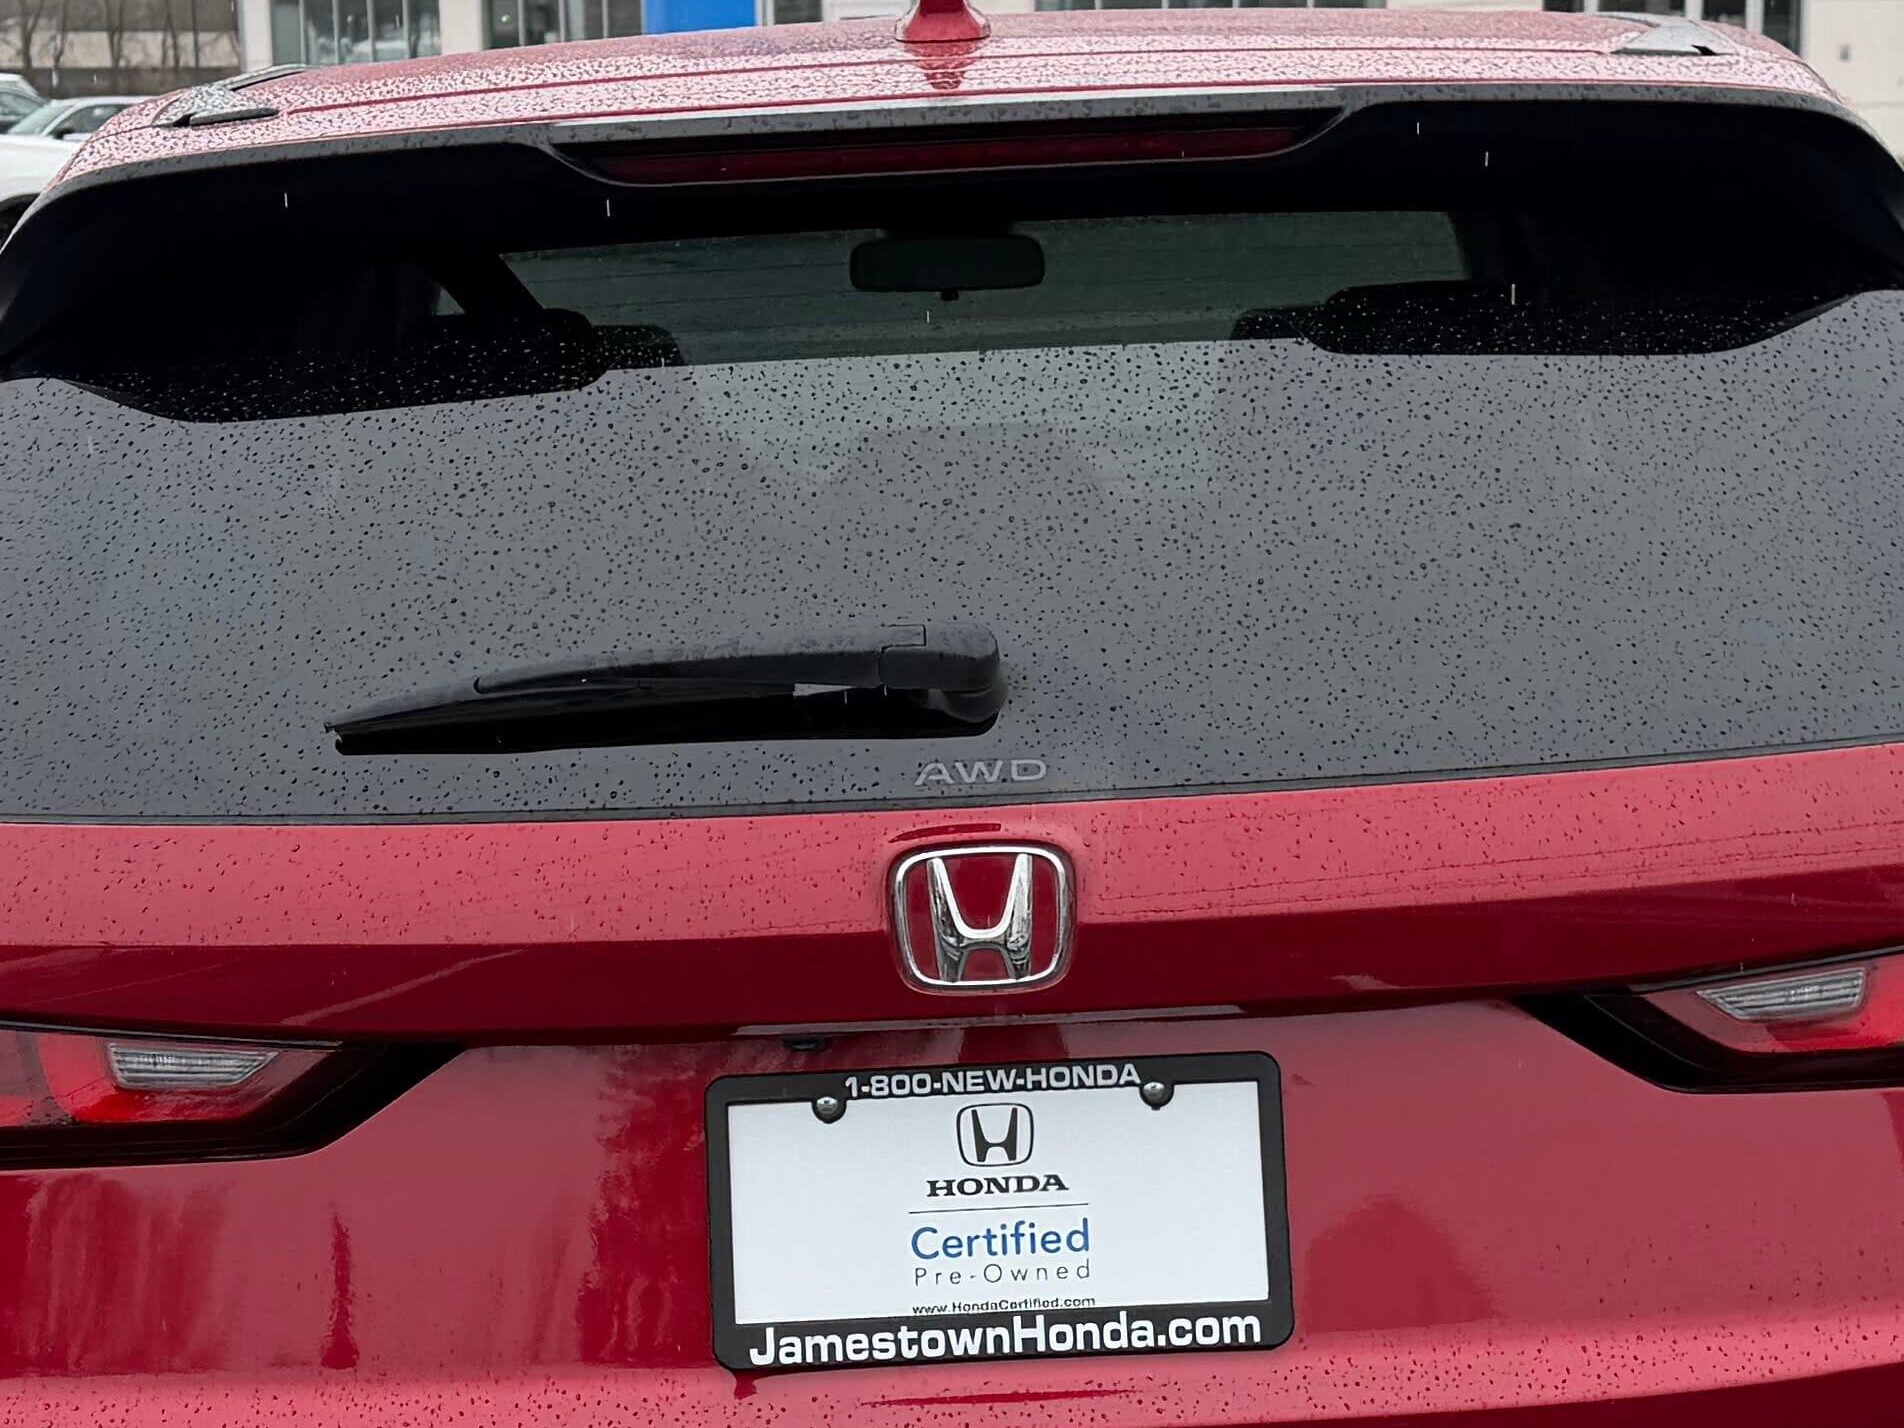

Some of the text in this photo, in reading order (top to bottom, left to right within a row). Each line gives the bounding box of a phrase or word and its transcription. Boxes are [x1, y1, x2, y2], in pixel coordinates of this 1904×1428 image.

[914, 759, 1047, 787] AWD
[844, 1063, 1142, 1099] 1-800-NEW-HONDA
[925, 1173, 1070, 1198] HONDA
[911, 1217, 1090, 1260] Certified
[914, 1258, 1091, 1287] Pre-Owned
[749, 1309, 1262, 1366] JamestownHonda.com
